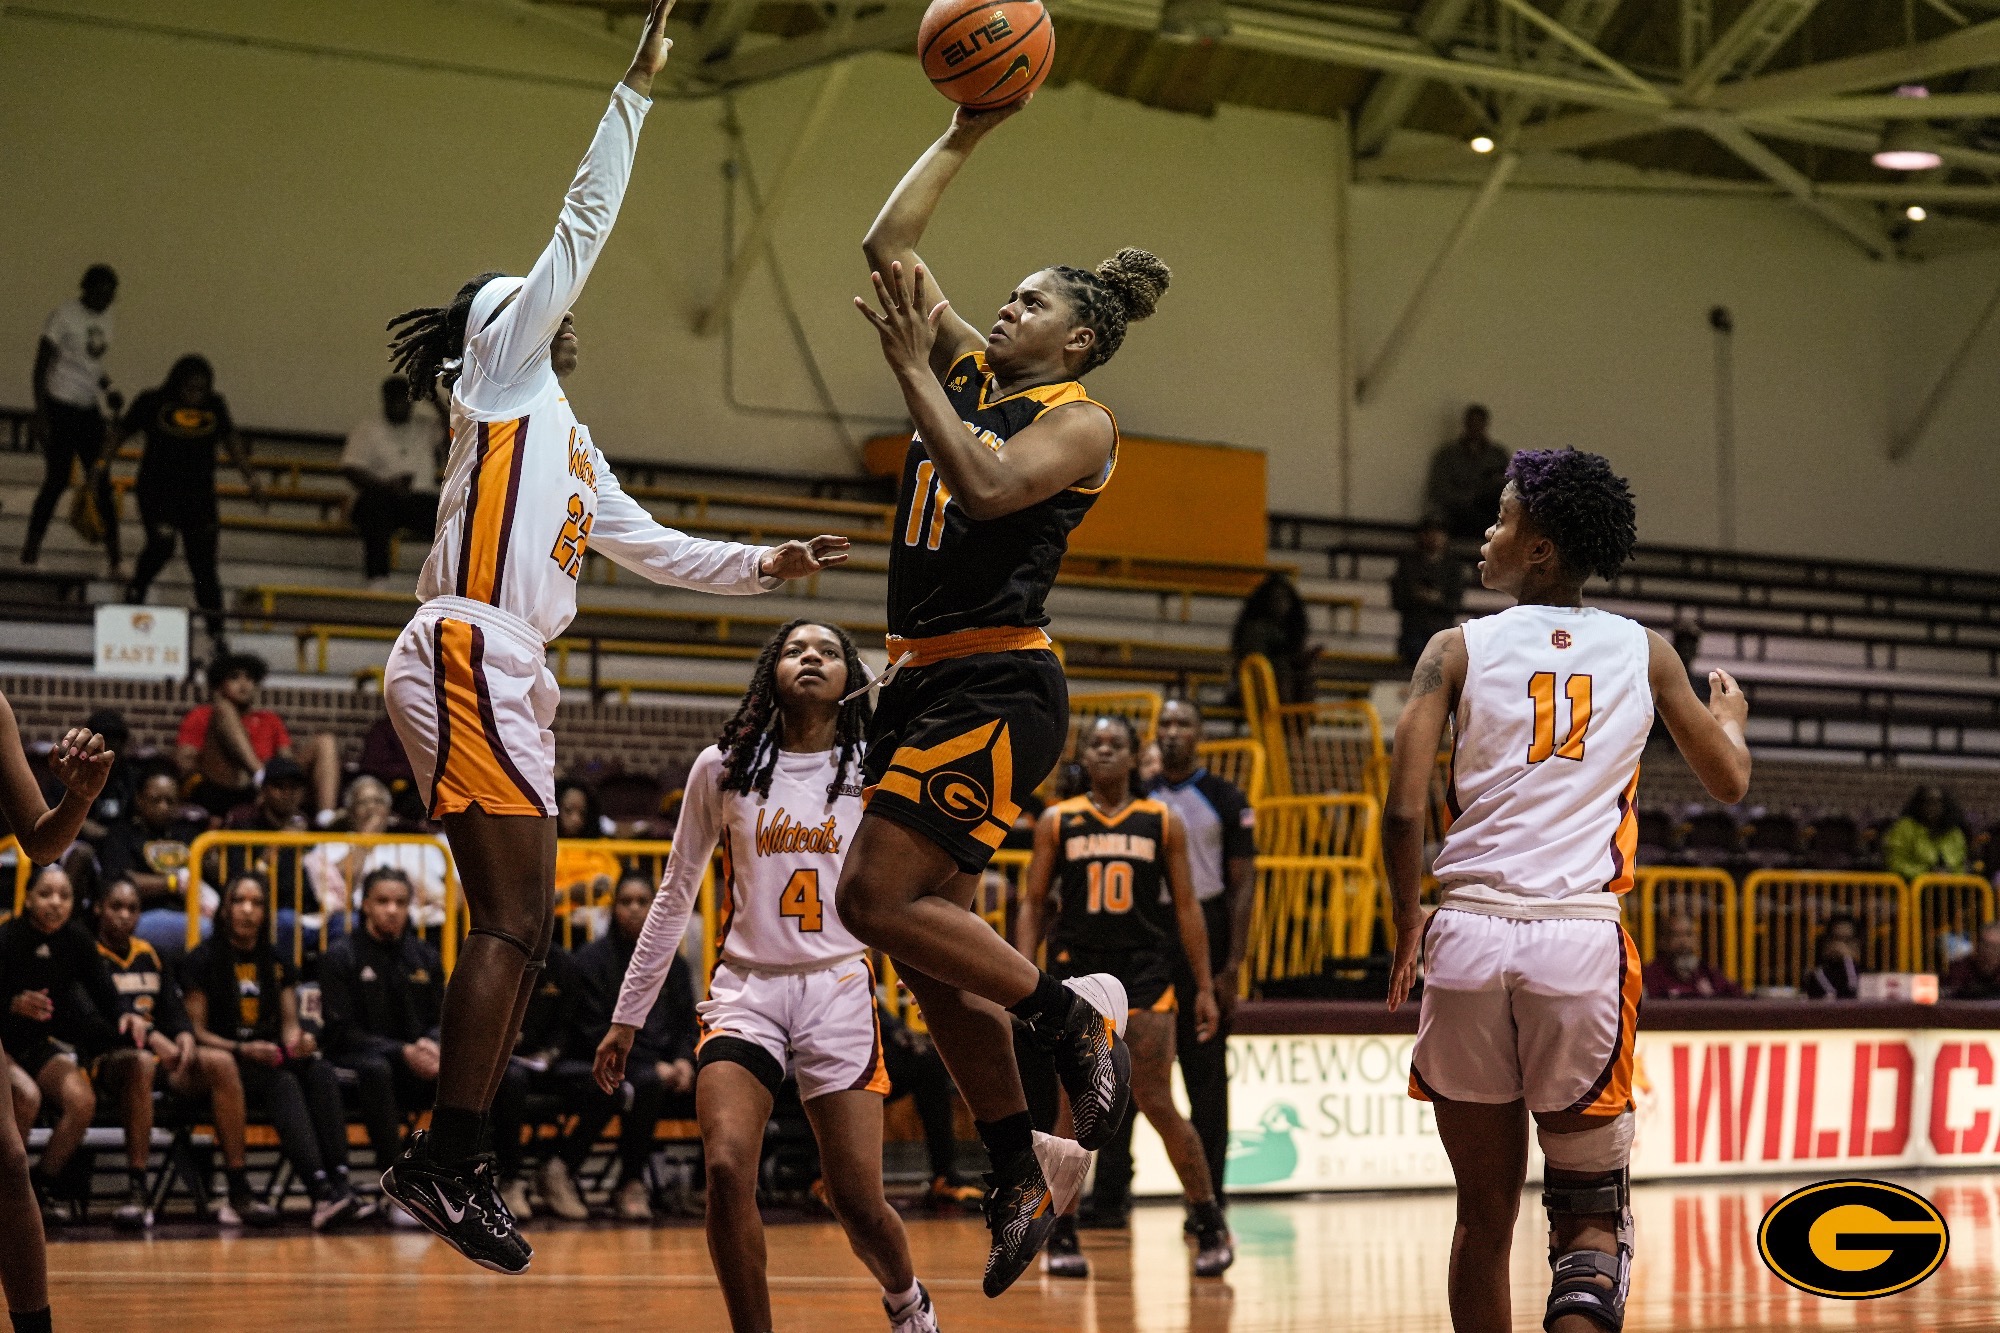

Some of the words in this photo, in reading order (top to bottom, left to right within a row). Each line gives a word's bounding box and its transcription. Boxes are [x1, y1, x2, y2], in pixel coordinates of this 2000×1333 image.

[941, 17, 1013, 68] ELITE
[1527, 671, 1592, 764] 11
[756, 807, 843, 858] Wildcats
[779, 868, 823, 932] 4
[1086, 861, 1134, 914] 10
[1671, 1042, 2000, 1164] WILDC
